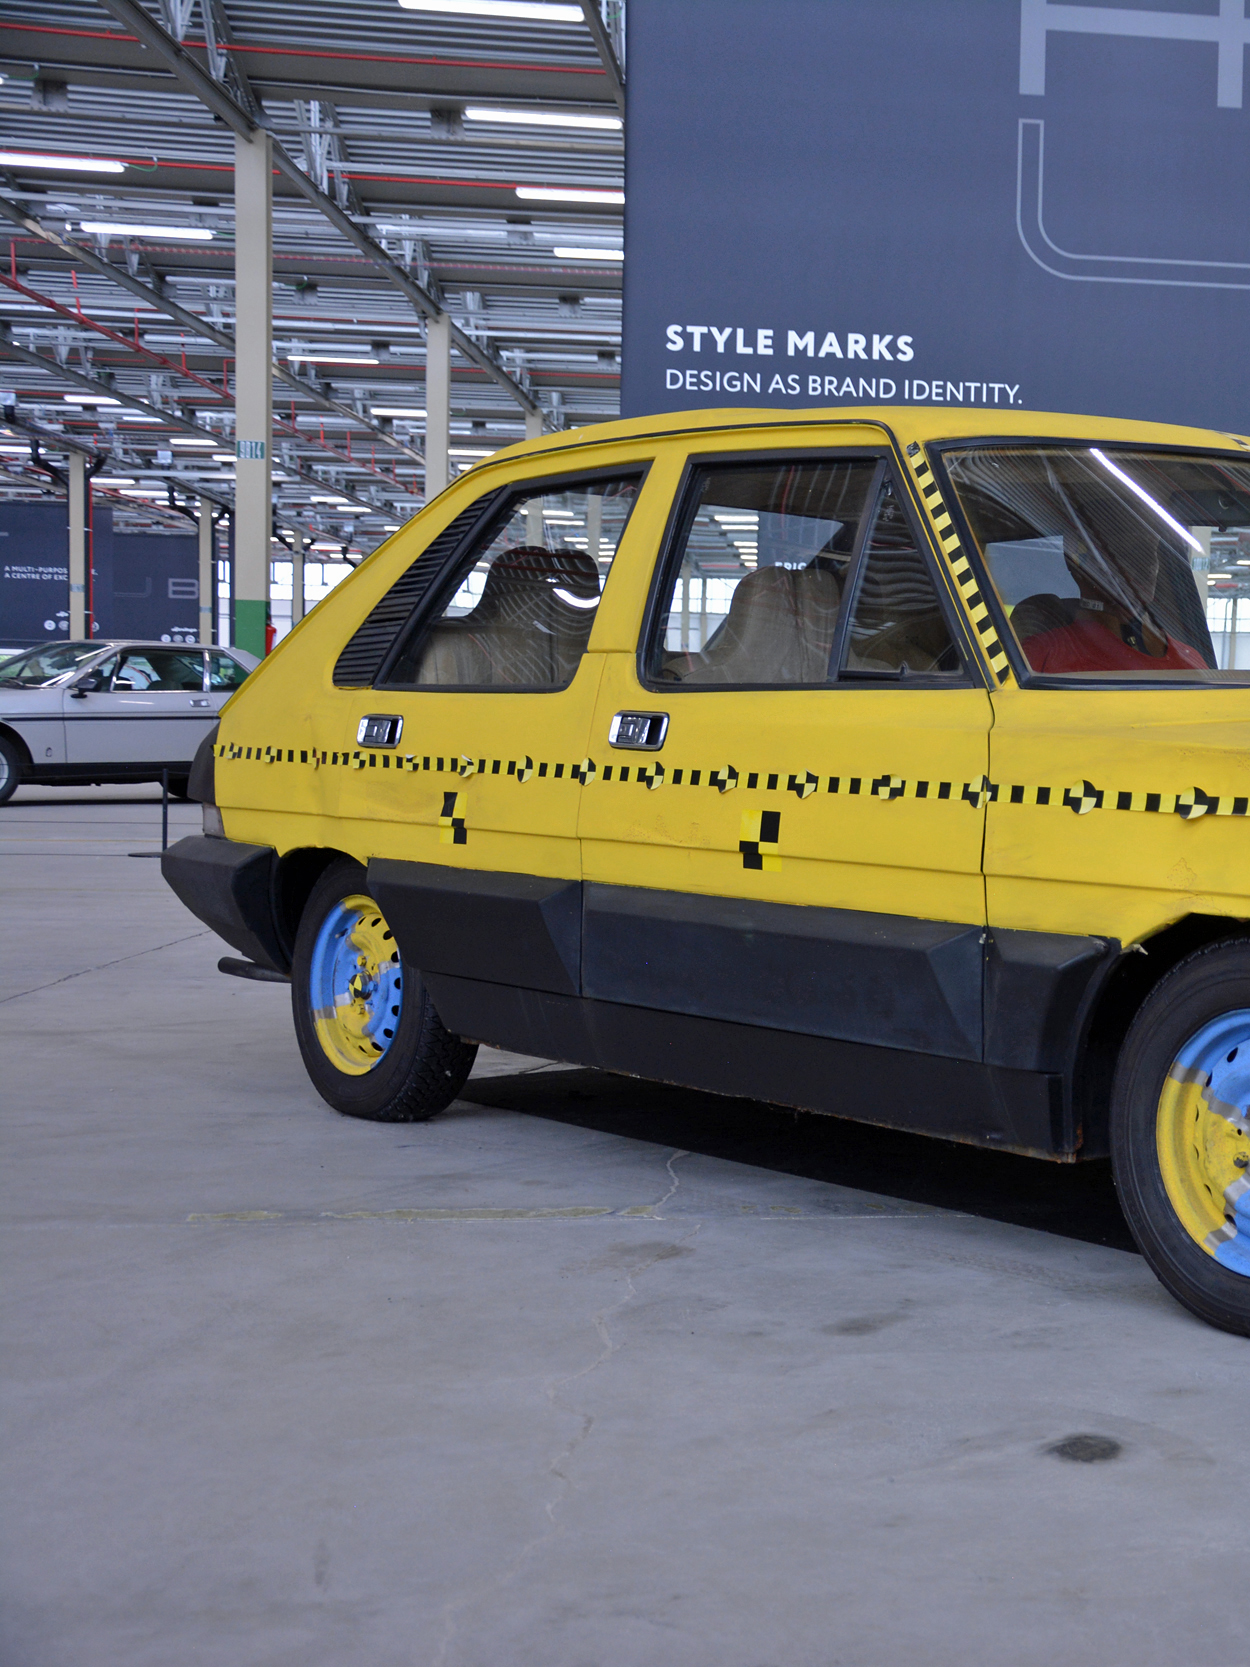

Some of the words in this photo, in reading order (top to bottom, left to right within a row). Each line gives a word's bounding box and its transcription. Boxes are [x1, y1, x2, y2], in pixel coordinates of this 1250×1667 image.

[665, 324, 774, 355] STYLE
[787, 330, 915, 362] MARKS
[665, 368, 761, 393] DESIGN
[768, 373, 801, 395] AS
[808, 375, 897, 399] BRAND
[904, 379, 1023, 404] IDENTITY.
[11, 565, 68, 574] MULTI-PURPOS
[11, 572, 40, 580] CENTRE
